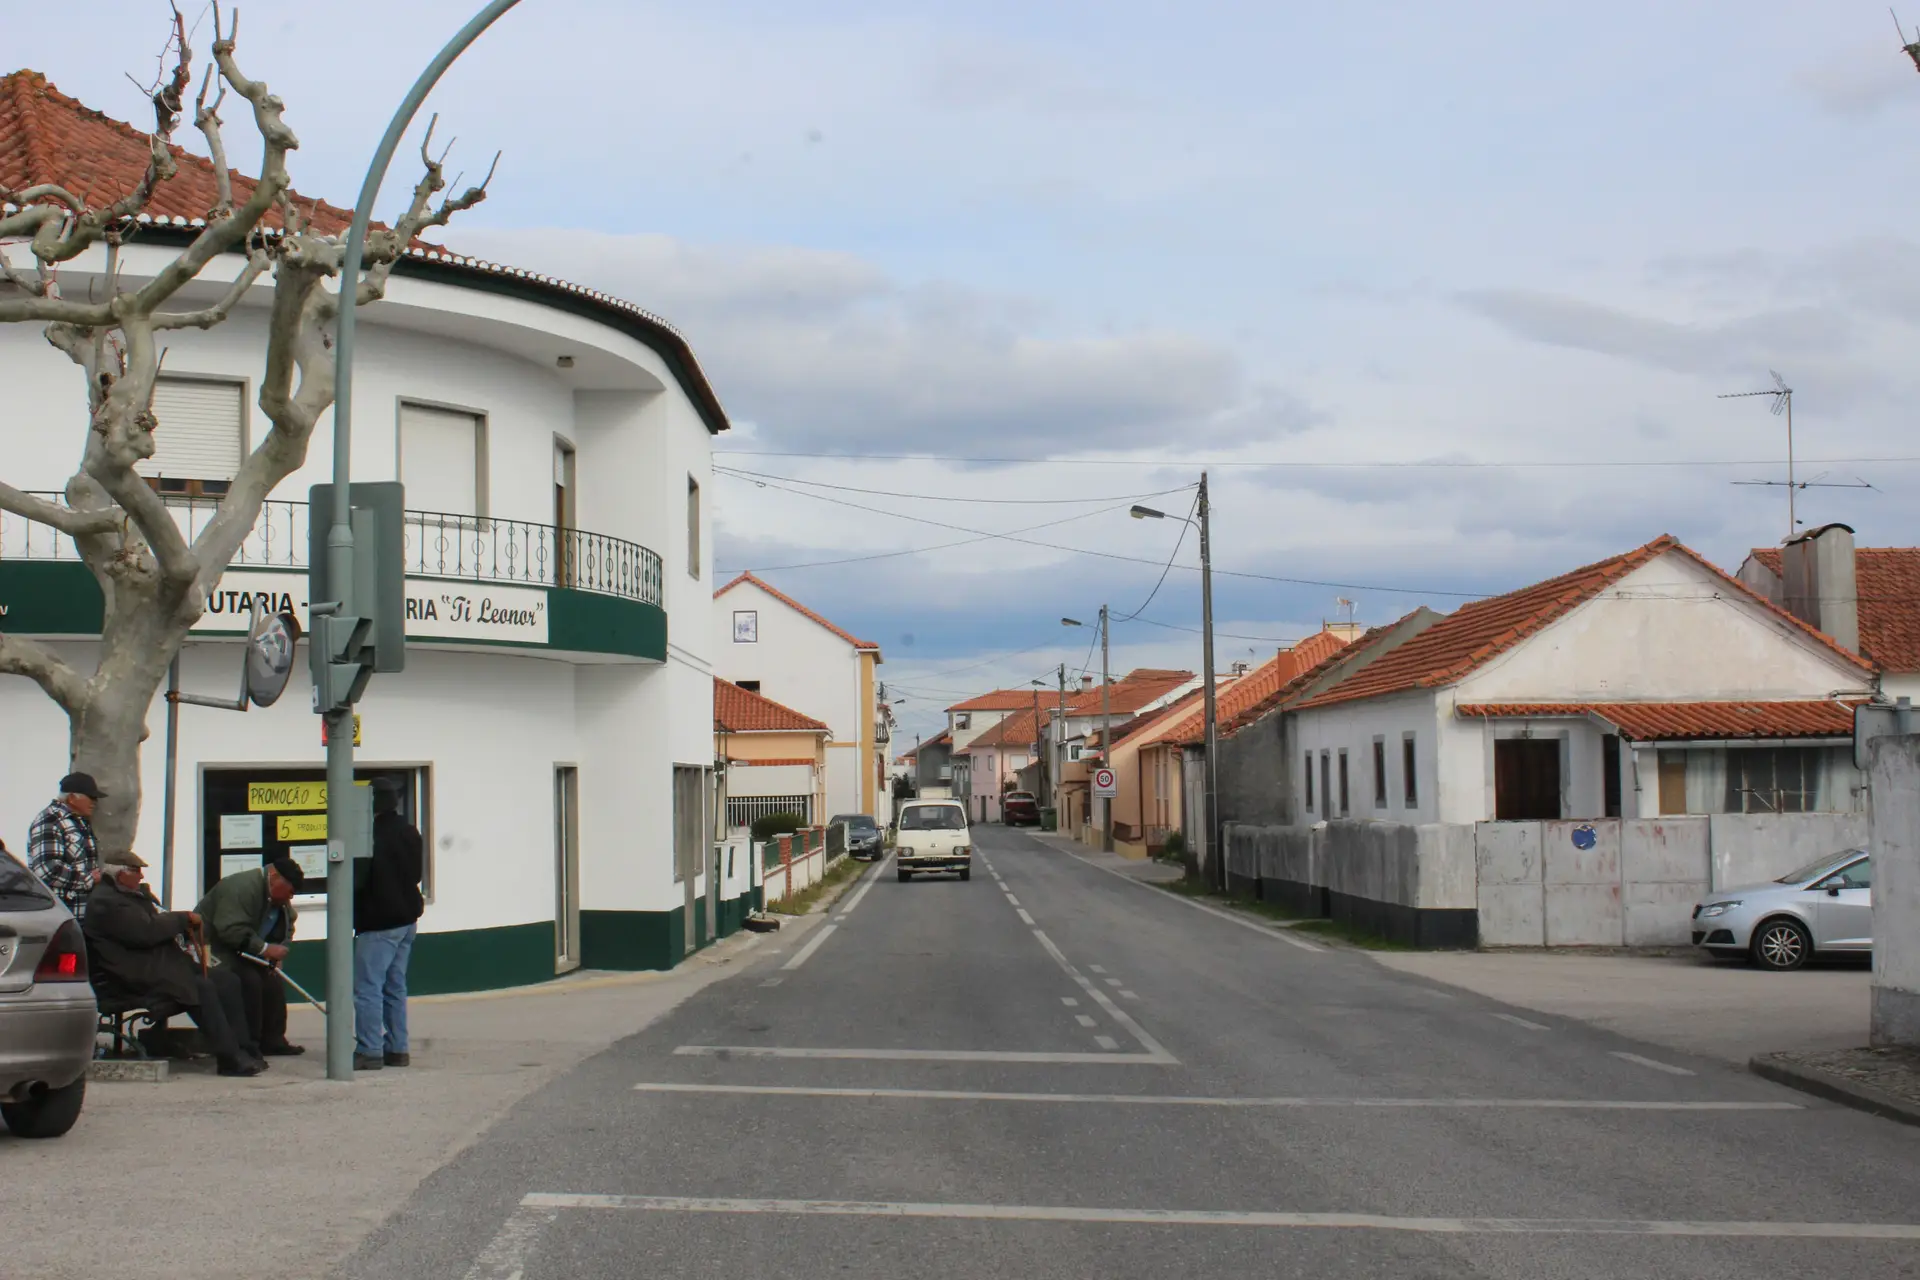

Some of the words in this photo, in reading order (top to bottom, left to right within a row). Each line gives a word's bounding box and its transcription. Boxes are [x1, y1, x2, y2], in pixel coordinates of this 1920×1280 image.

[203, 590, 295, 615] UTARIA
[406, 598, 438, 620] RIA
[1100, 775, 1110, 783] 50
[250, 786, 310, 807] PROMOÇÃO
[280, 818, 292, 839] 5
